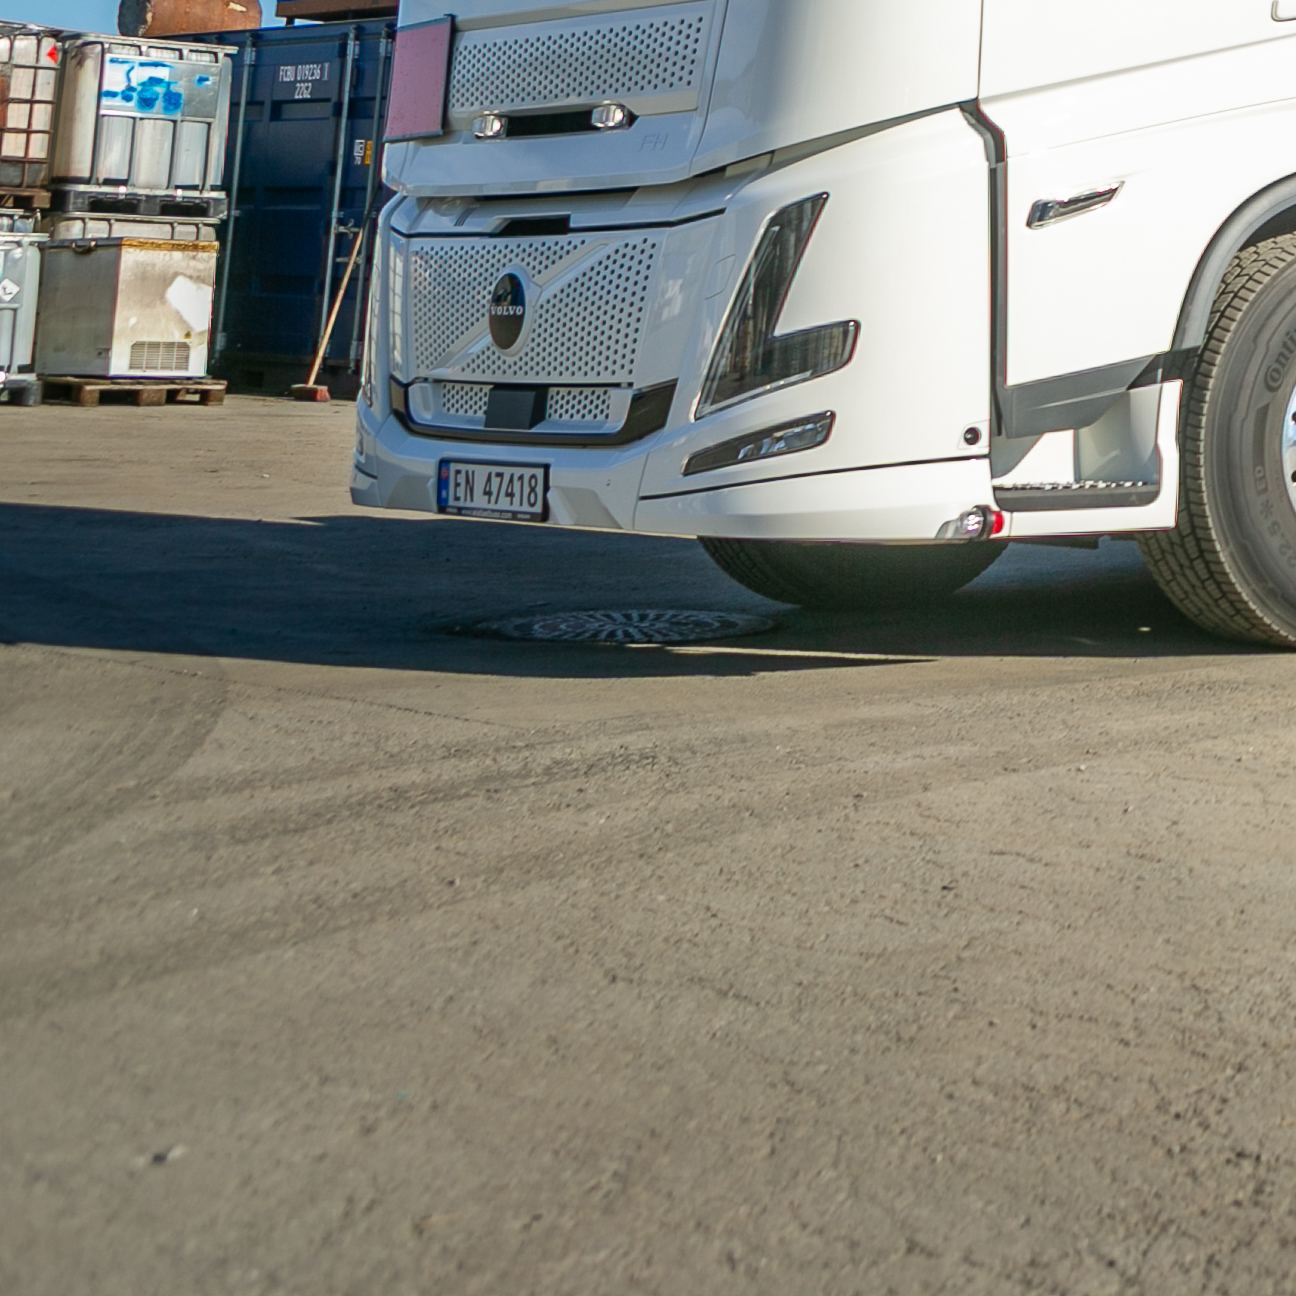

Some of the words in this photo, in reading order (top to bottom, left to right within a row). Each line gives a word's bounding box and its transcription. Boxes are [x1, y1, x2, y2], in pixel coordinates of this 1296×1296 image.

[297, 63, 321, 81] 019236
[638, 132, 669, 152] FH
[490, 304, 525, 316] VOLVO
[453, 468, 476, 503] EN
[482, 470, 538, 508] 47418
